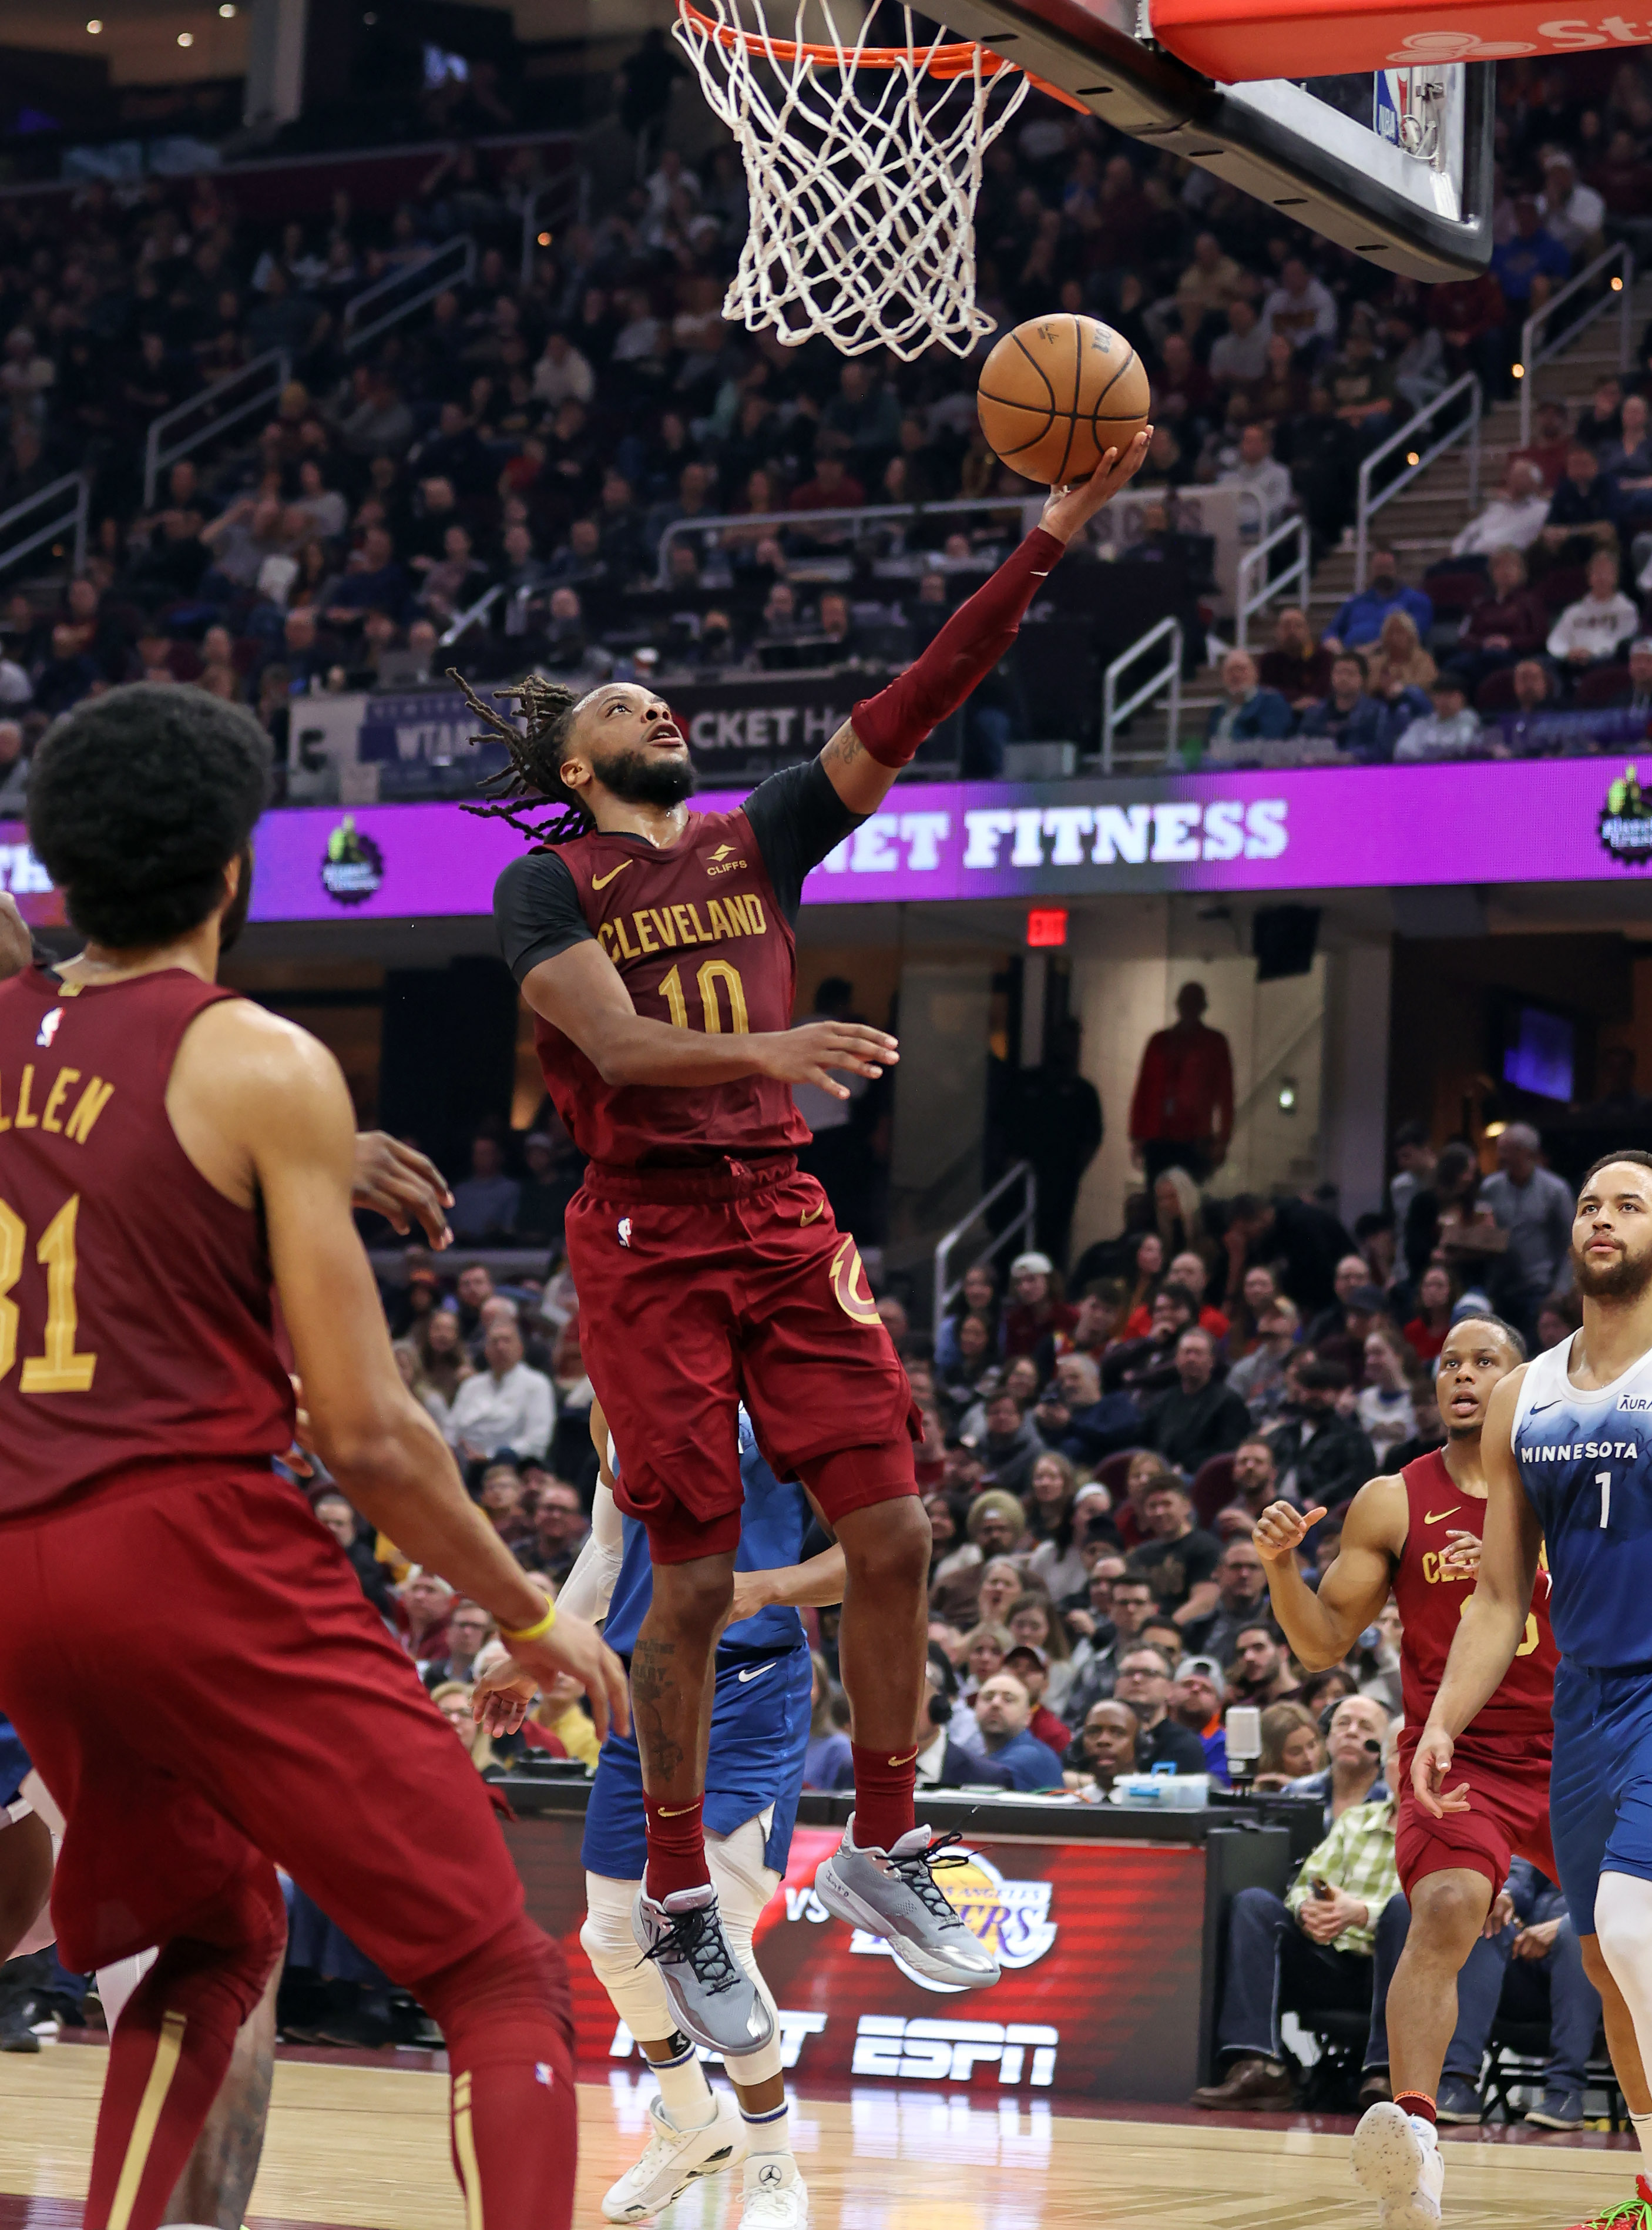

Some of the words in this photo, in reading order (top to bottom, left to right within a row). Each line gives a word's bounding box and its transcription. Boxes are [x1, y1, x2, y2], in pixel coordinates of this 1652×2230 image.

[1537, 15, 1652, 48] St
[963, 799, 1288, 869] FITNESS
[706, 860, 748, 877] CLIFFS
[598, 893, 767, 964] CLEVELAND
[658, 959, 750, 1034] 10
[1521, 1441, 1638, 1464] MINNESOTA
[1595, 1471, 1611, 1528] 1
[785, 1886, 830, 1923] VS
[851, 2014, 1059, 2087] ESPN
